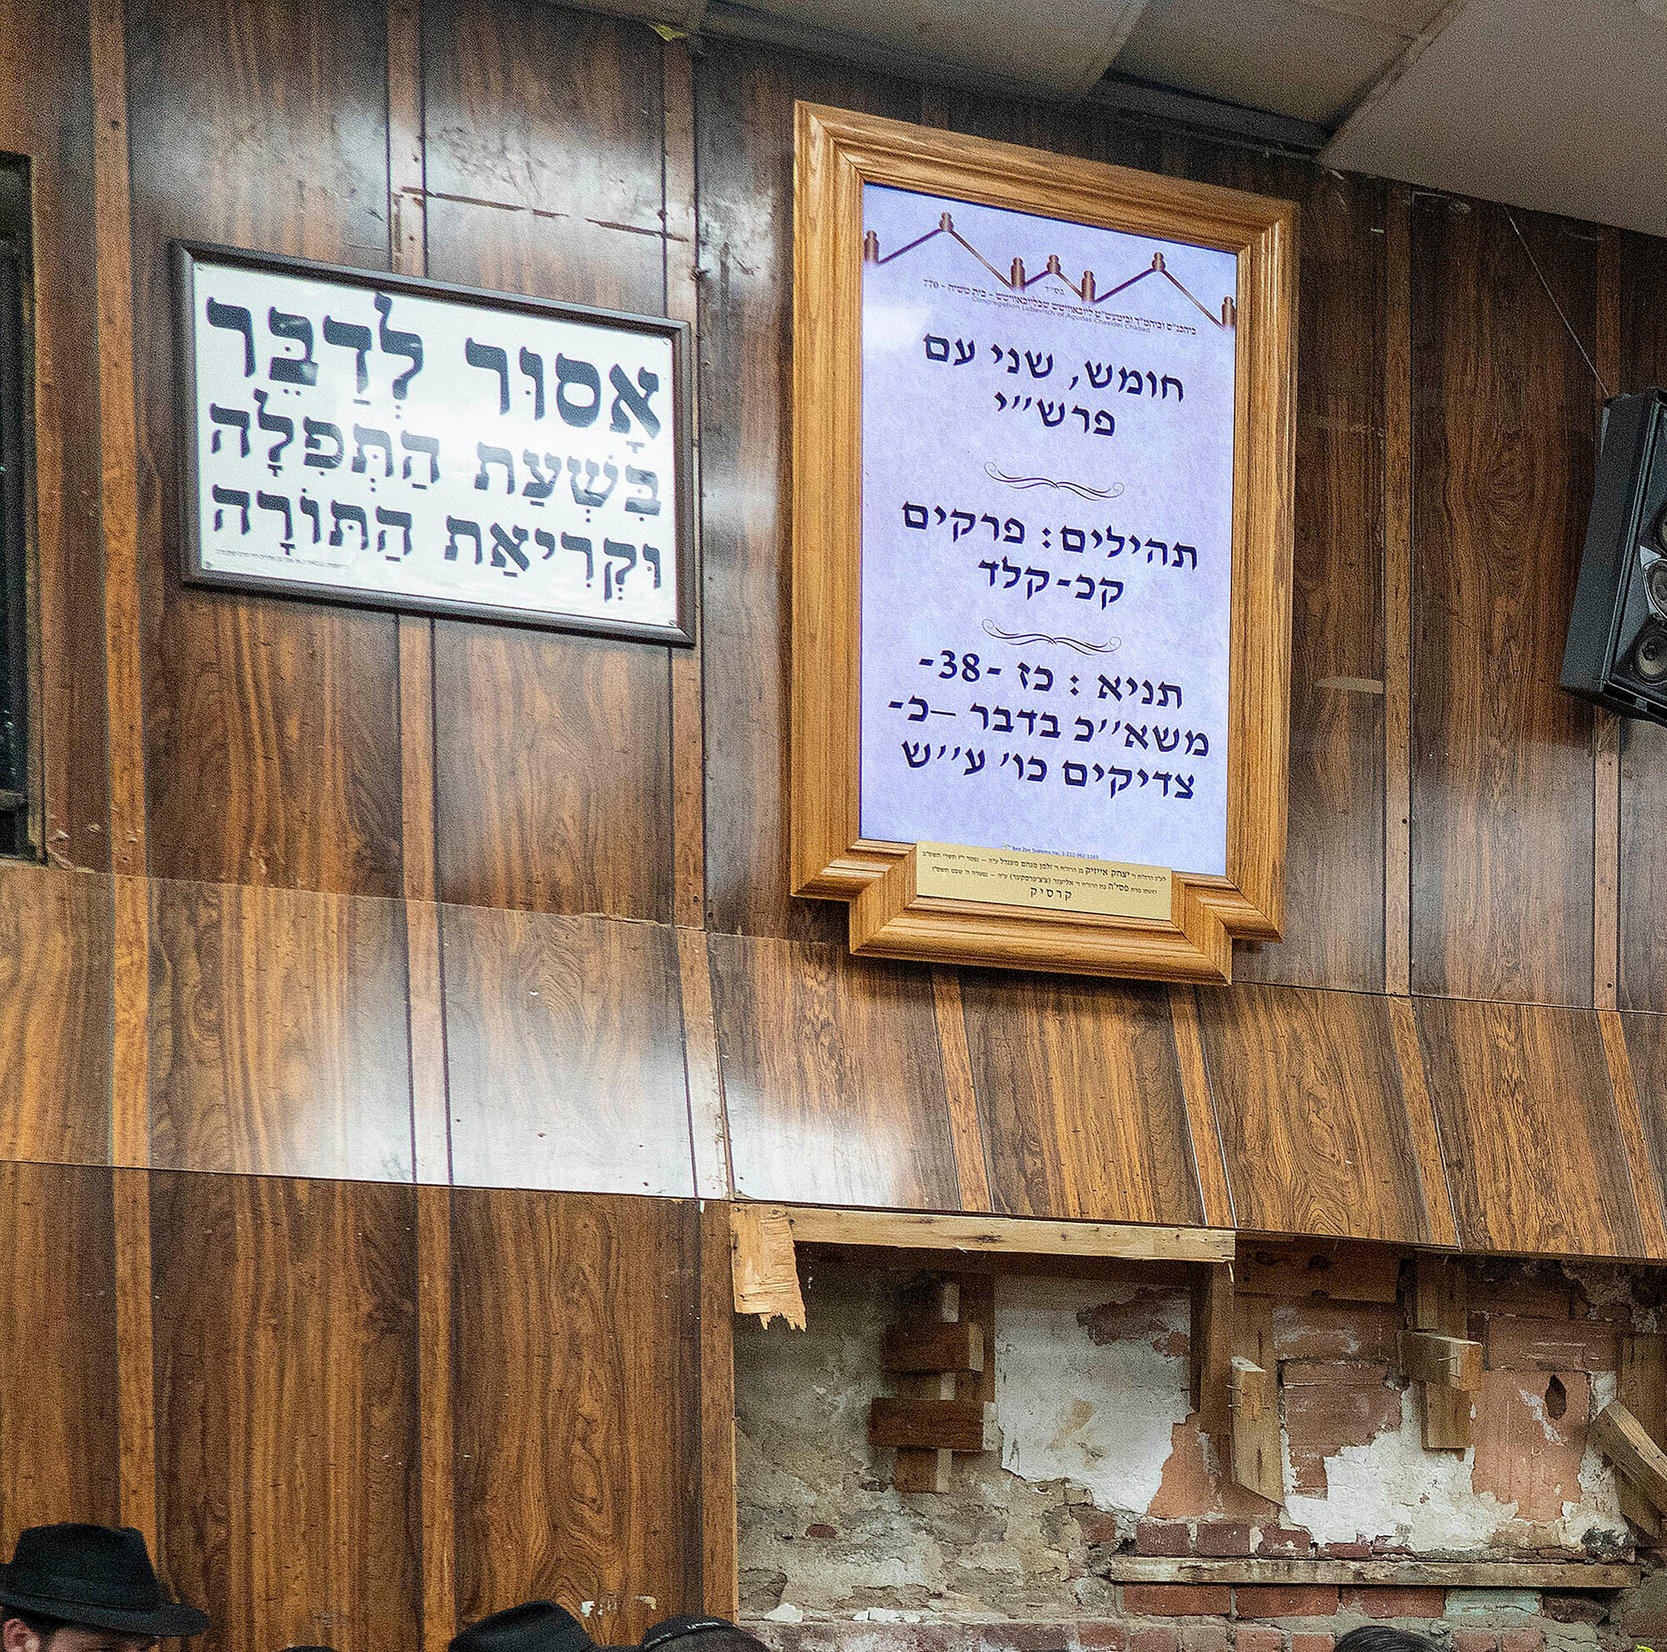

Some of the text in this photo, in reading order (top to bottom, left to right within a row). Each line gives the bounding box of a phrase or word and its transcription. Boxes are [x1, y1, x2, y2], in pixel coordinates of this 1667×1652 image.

[922, 333, 1186, 402] חומש, שני עם
[902, 501, 1026, 544] פרקים
[1016, 662, 1054, 692] כז
[1097, 673, 1184, 709] תניא
[969, 701, 1062, 739] בדבר
[1062, 759, 1196, 801] צדיקים
